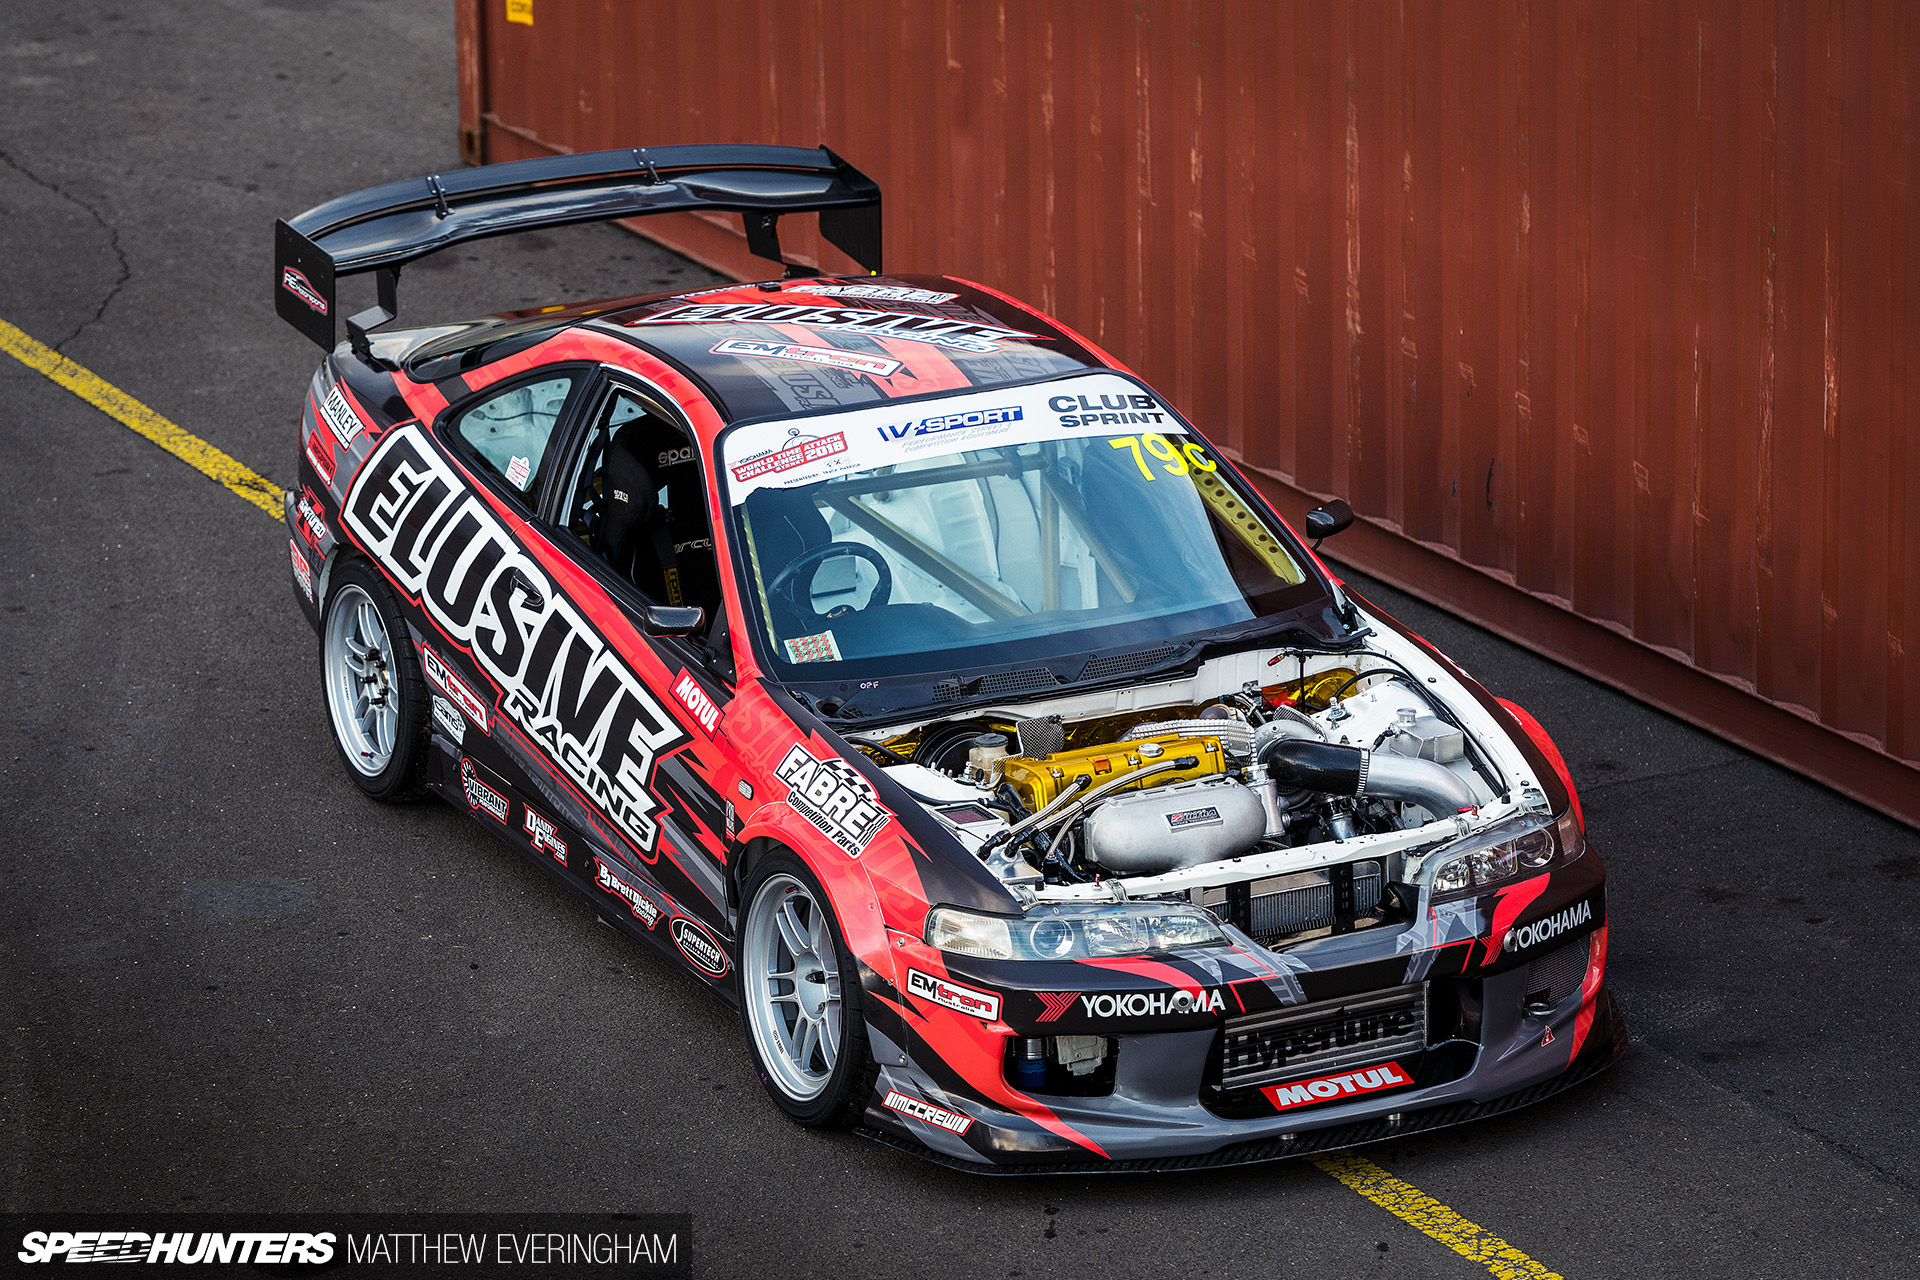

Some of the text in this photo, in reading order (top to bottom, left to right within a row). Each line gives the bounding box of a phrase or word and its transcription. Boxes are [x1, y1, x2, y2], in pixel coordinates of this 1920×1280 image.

[642, 304, 1036, 342] ELUSIVE
[326, 391, 357, 434] MANLEY
[1048, 395, 1157, 412] CLUB
[1059, 412, 1164, 428] SPRINT
[736, 435, 842, 473] WORLD TIME ATTACK
[902, 430, 967, 448] PERFORMANCE
[970, 424, 1001, 434] STREET
[905, 428, 1009, 453] COMPETITION EQUIPMENT
[740, 440, 845, 480] CHALLENGE 2018
[1108, 433, 1189, 482] 79
[345, 426, 682, 812] ELUSIVE
[675, 675, 721, 733] MOTUL
[504, 689, 657, 850] RACING
[468, 777, 508, 815] VIBRANT
[775, 744, 882, 841] FABRE
[526, 809, 554, 836] DANDY
[787, 790, 861, 857] Competition Parts
[683, 928, 721, 963] SUPERTECH
[910, 972, 993, 1013] EMtron
[1275, 1066, 1404, 1107] MOTUL
